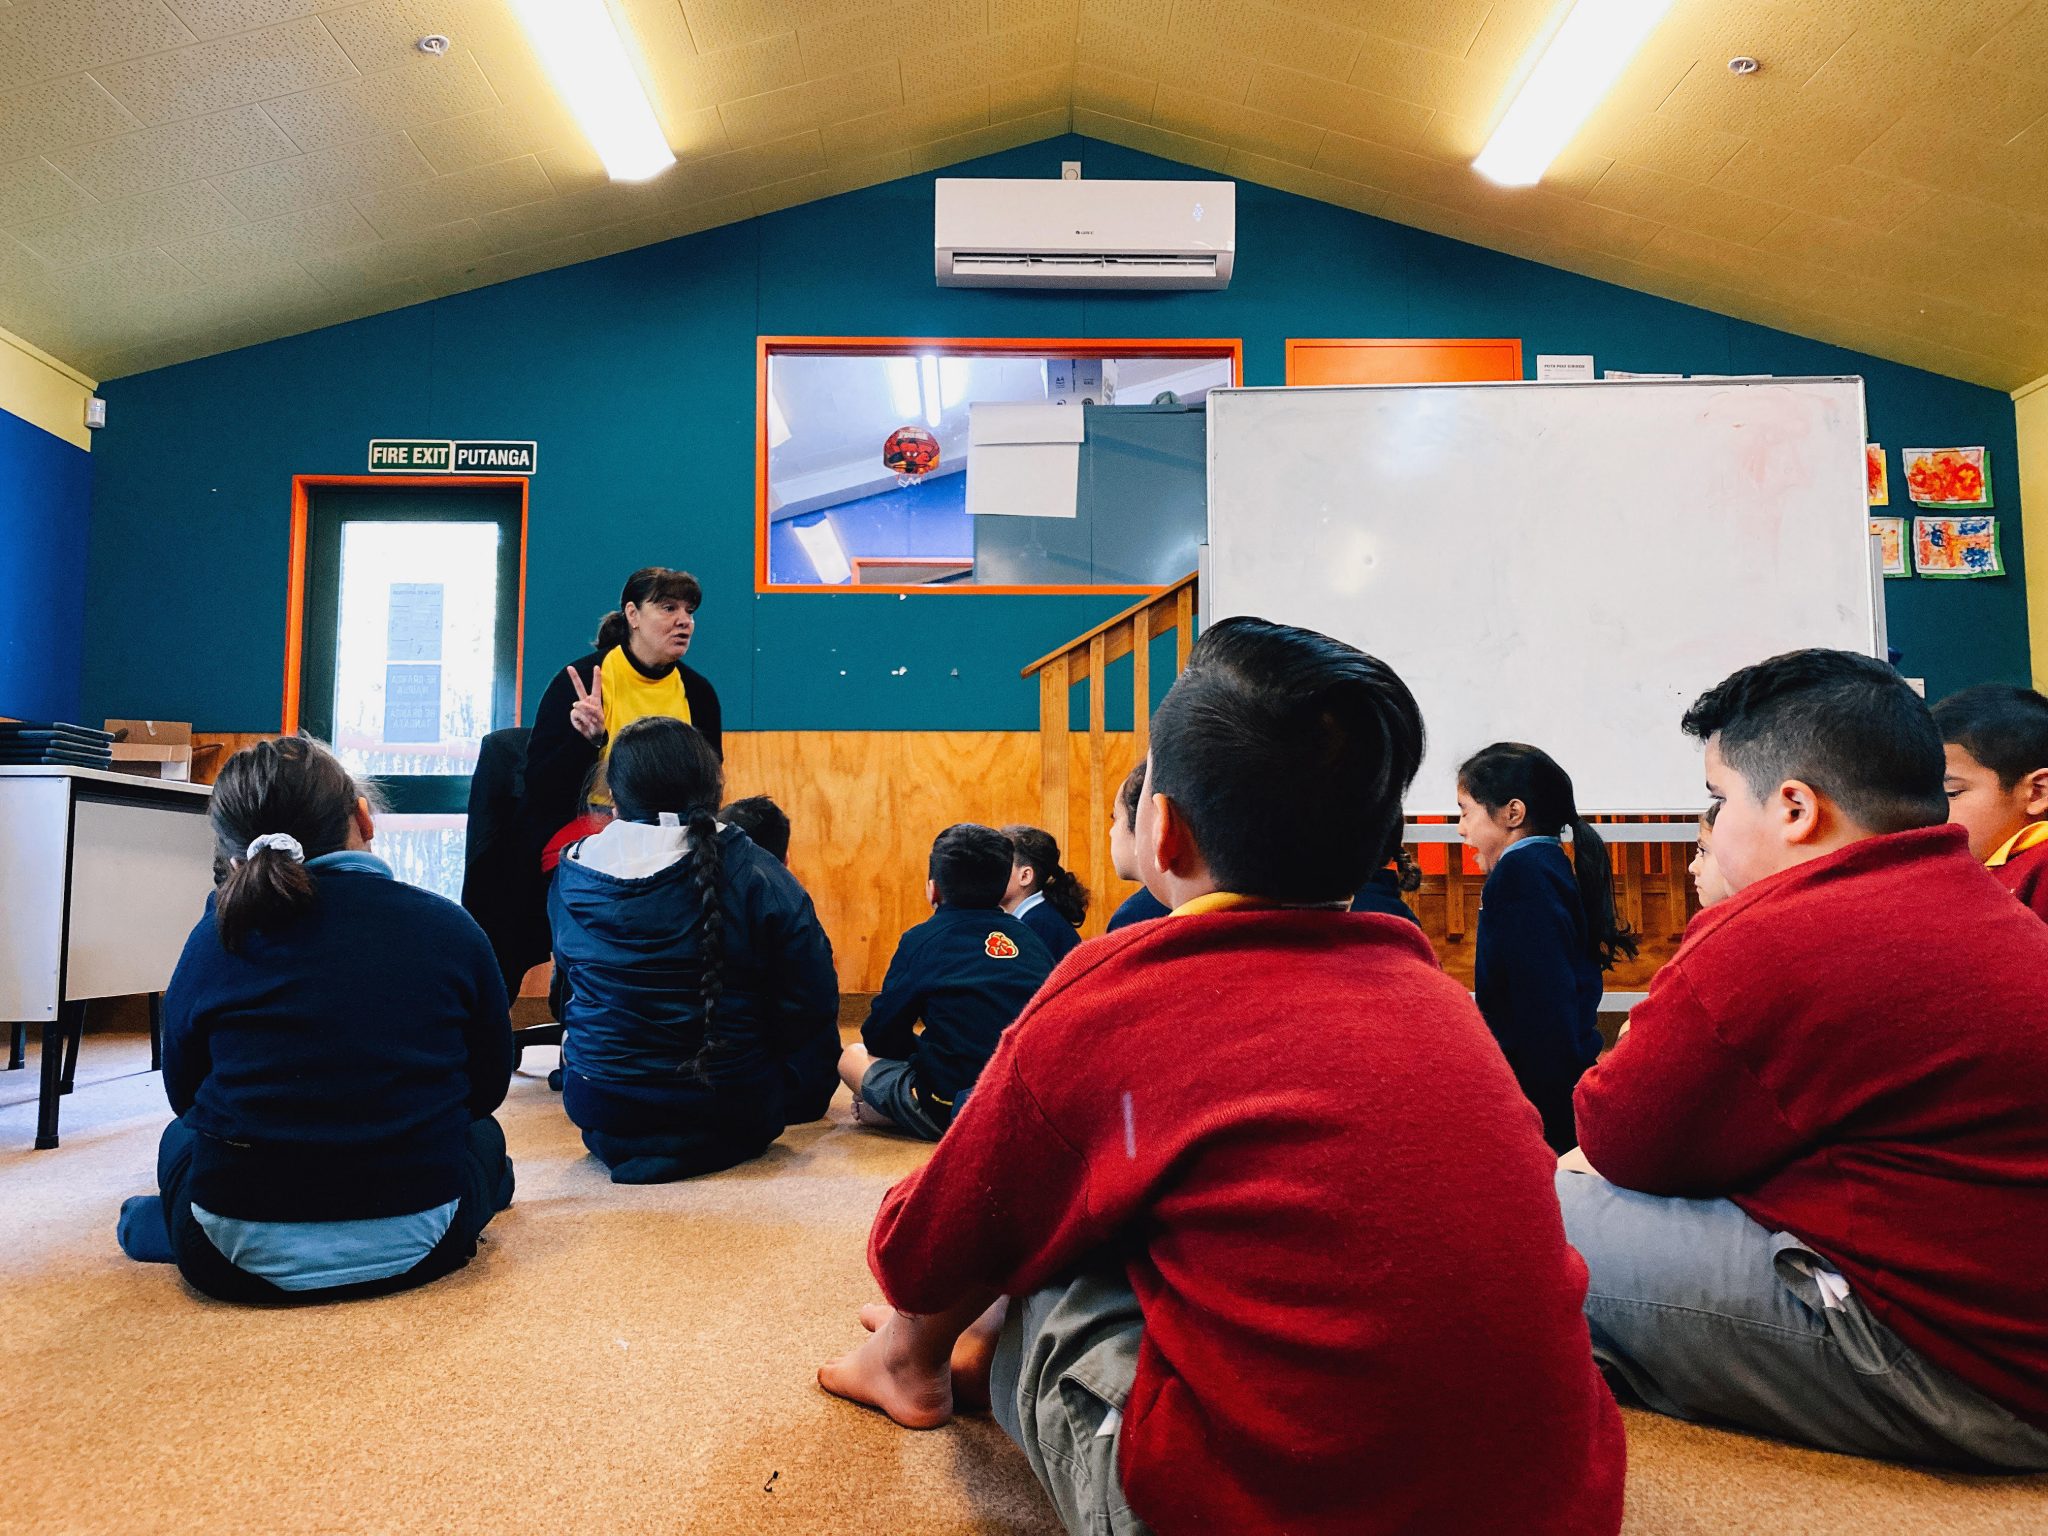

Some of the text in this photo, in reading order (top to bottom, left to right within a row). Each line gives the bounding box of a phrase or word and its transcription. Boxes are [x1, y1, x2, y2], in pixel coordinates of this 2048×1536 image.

[373, 447, 448, 464] FIRE EXIT
[458, 449, 530, 466] PUTANGA
